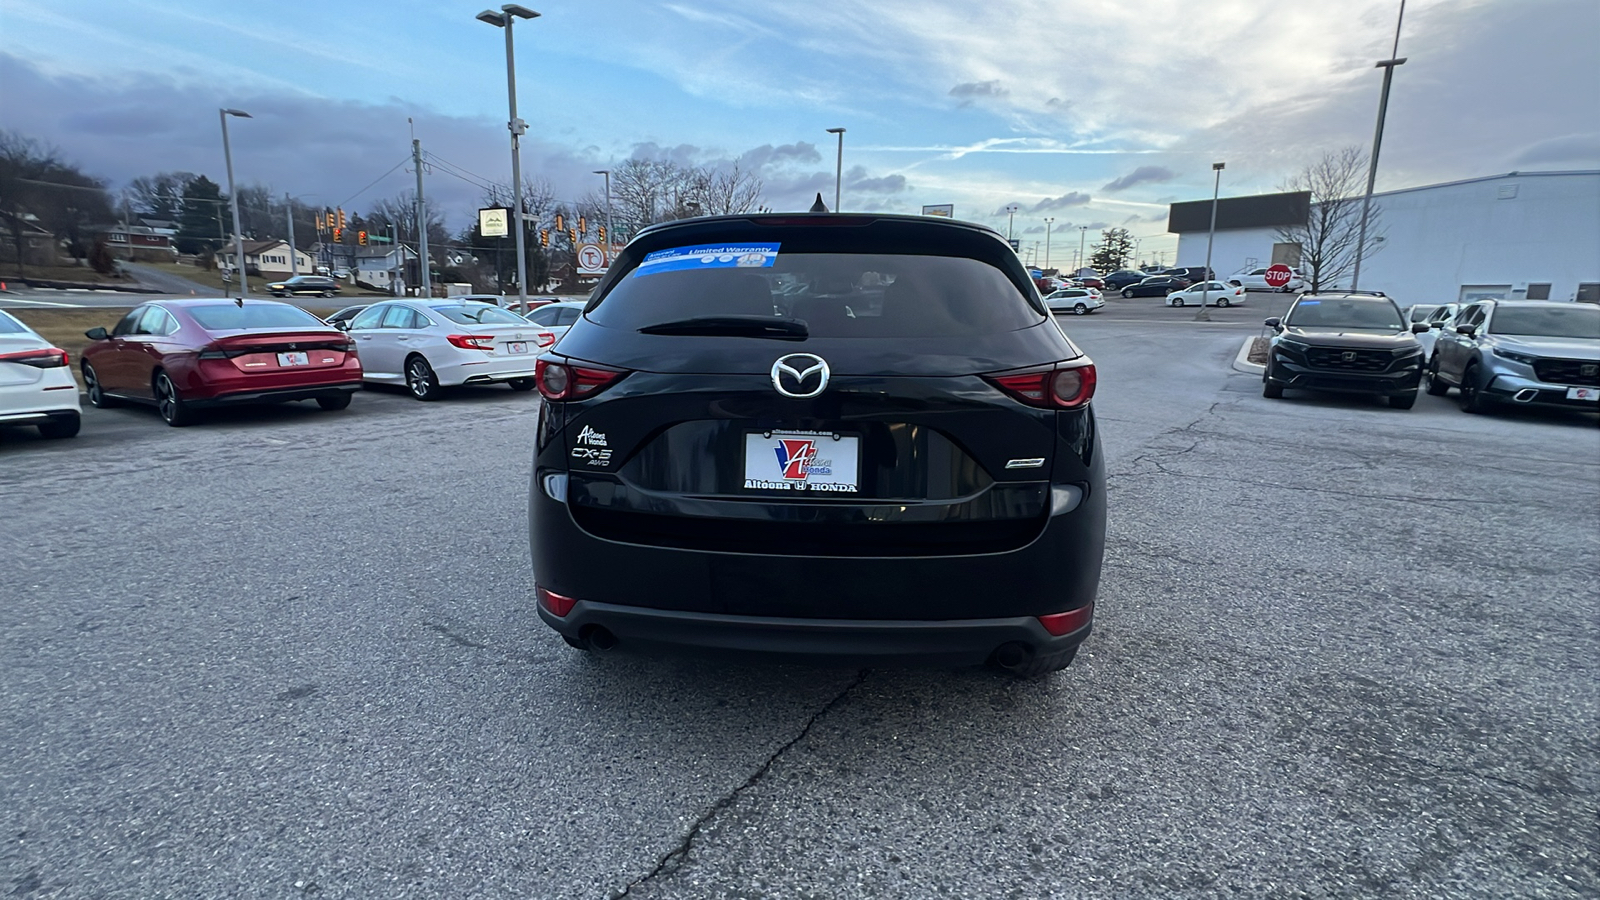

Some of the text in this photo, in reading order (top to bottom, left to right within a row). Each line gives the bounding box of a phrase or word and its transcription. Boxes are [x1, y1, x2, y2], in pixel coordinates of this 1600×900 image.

[688, 247, 725, 255] Limited
[1266, 270, 1291, 281] STOP
[571, 447, 613, 460] CX-5
[586, 459, 610, 467] AWD
[803, 466, 832, 475] Honda
[744, 480, 791, 490] Altoona
[810, 483, 858, 493] HONDA
